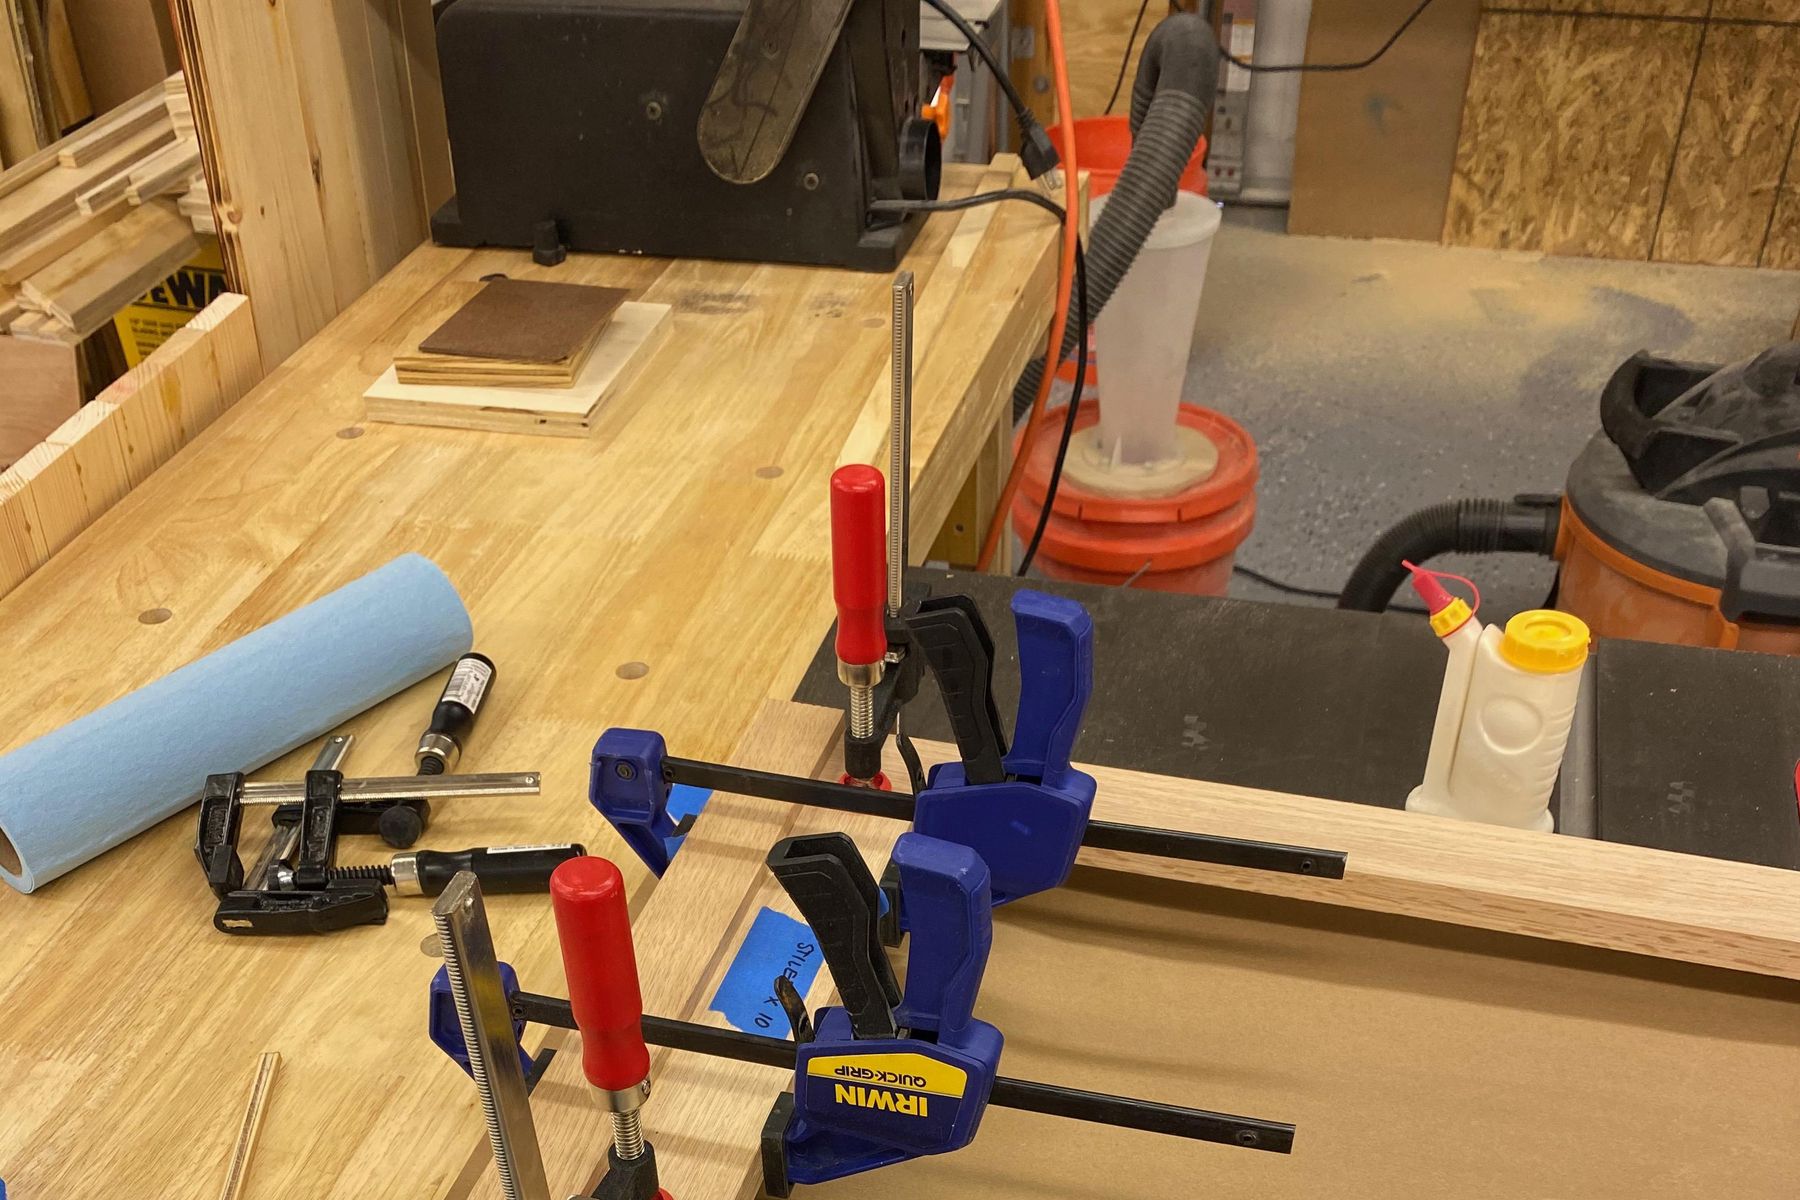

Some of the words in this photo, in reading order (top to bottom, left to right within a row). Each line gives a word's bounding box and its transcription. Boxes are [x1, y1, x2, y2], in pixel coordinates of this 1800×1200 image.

[138, 270, 228, 307] EWA
[783, 942, 815, 984] STILE
[834, 1083, 928, 1118] IRWIN
